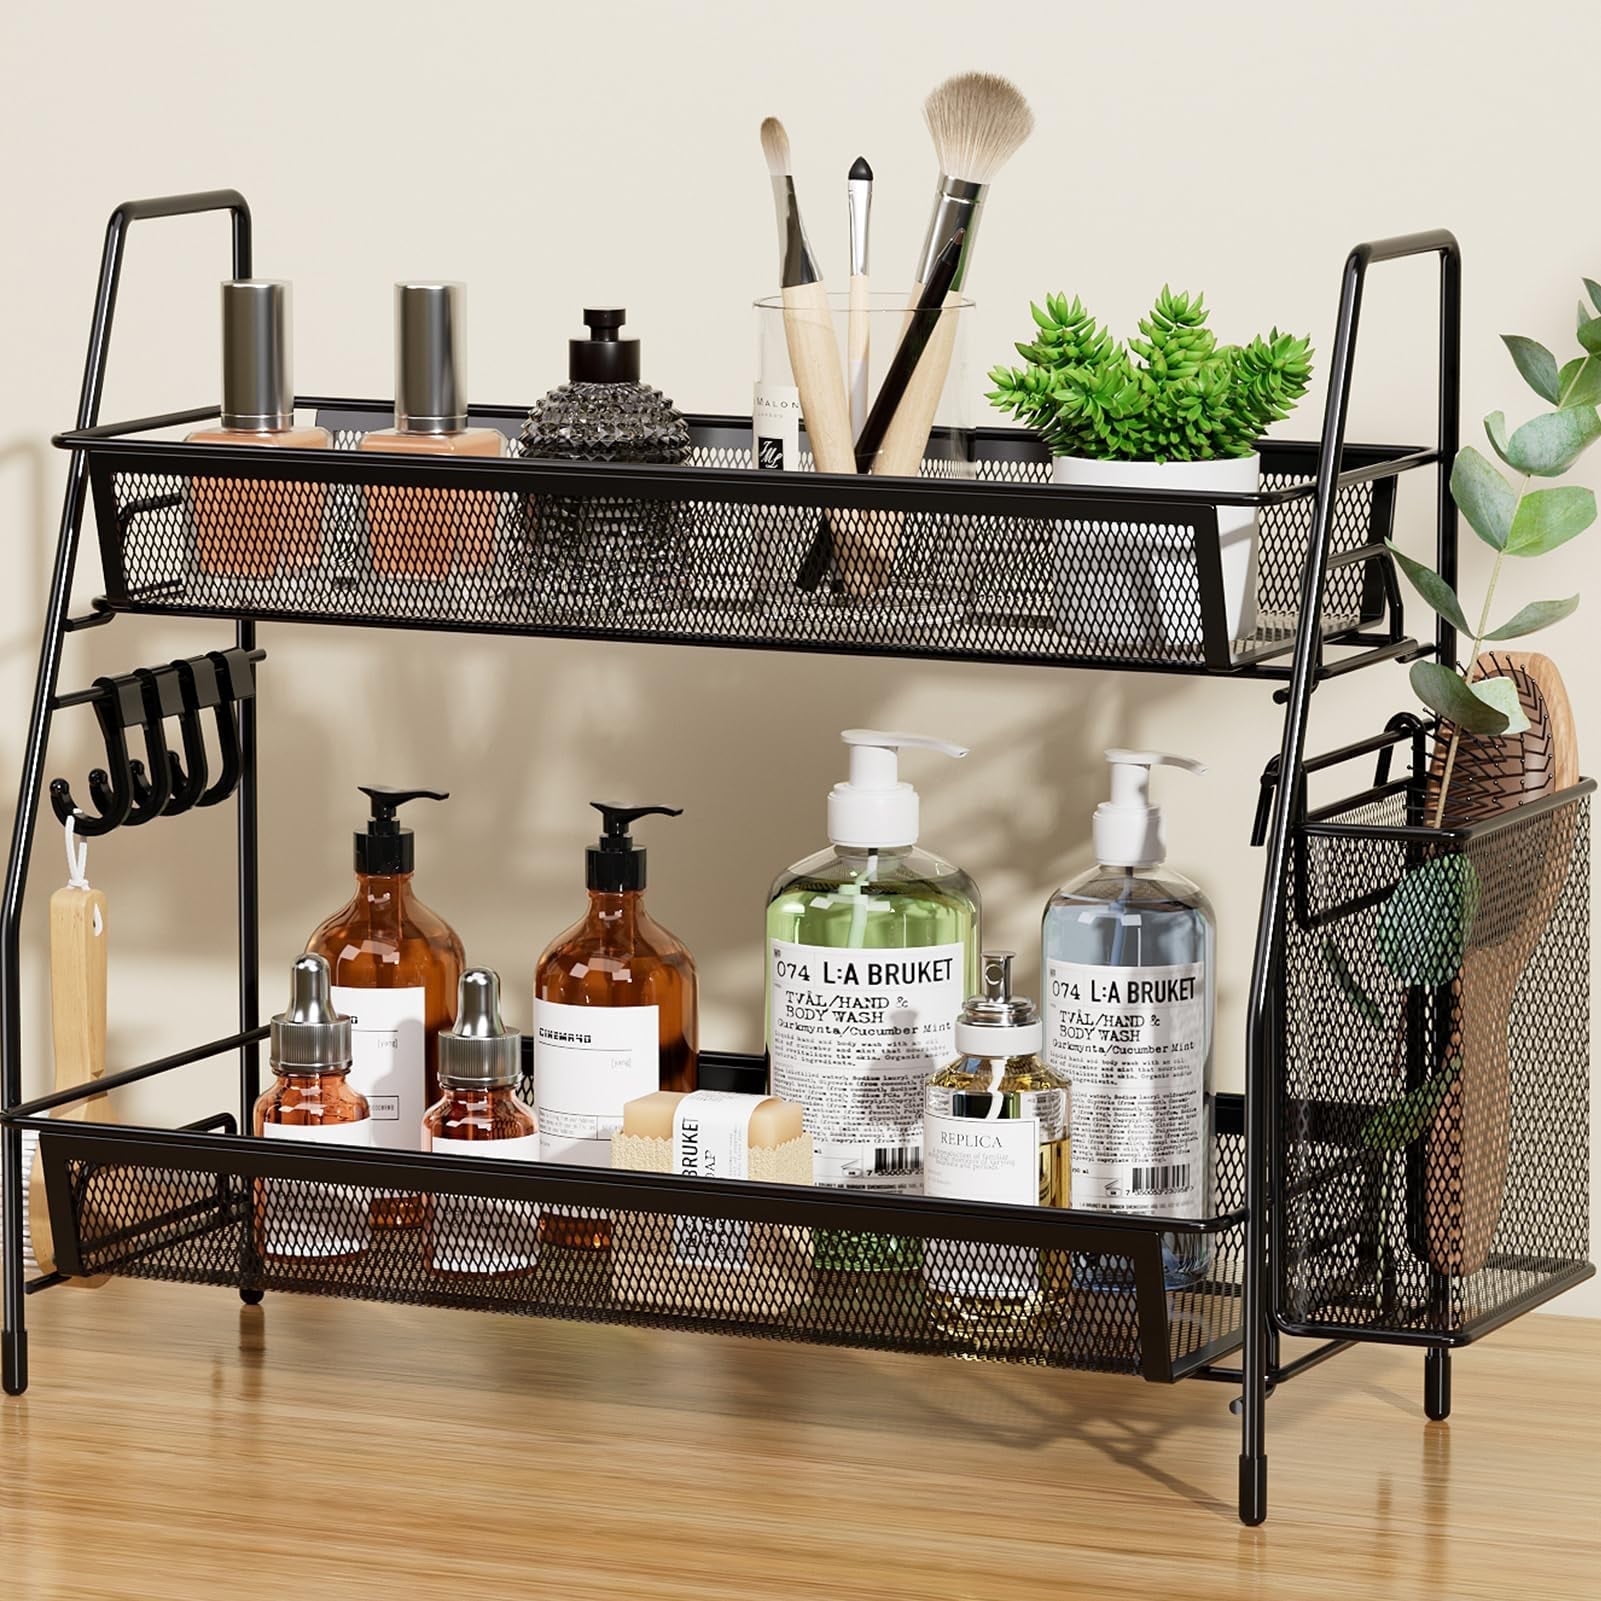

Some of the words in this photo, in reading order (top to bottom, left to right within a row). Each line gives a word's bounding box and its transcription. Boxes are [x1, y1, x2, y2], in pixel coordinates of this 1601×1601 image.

[777, 960, 810, 982] 074
[823, 961, 859, 985] L:A
[868, 958, 953, 985] BRUKET
[1052, 980, 1080, 1001] 074
[1091, 979, 1121, 1004] L:A
[1127, 977, 1196, 1004] BRUKET
[786, 1005, 829, 1021] BODY
[832, 1011, 884, 1024] WASH
[923, 1022, 951, 1033] Mint
[1060, 1024, 1095, 1041] BODY
[1098, 1029, 1140, 1043] WASH
[941, 1131, 1002, 1149] REPLICA
